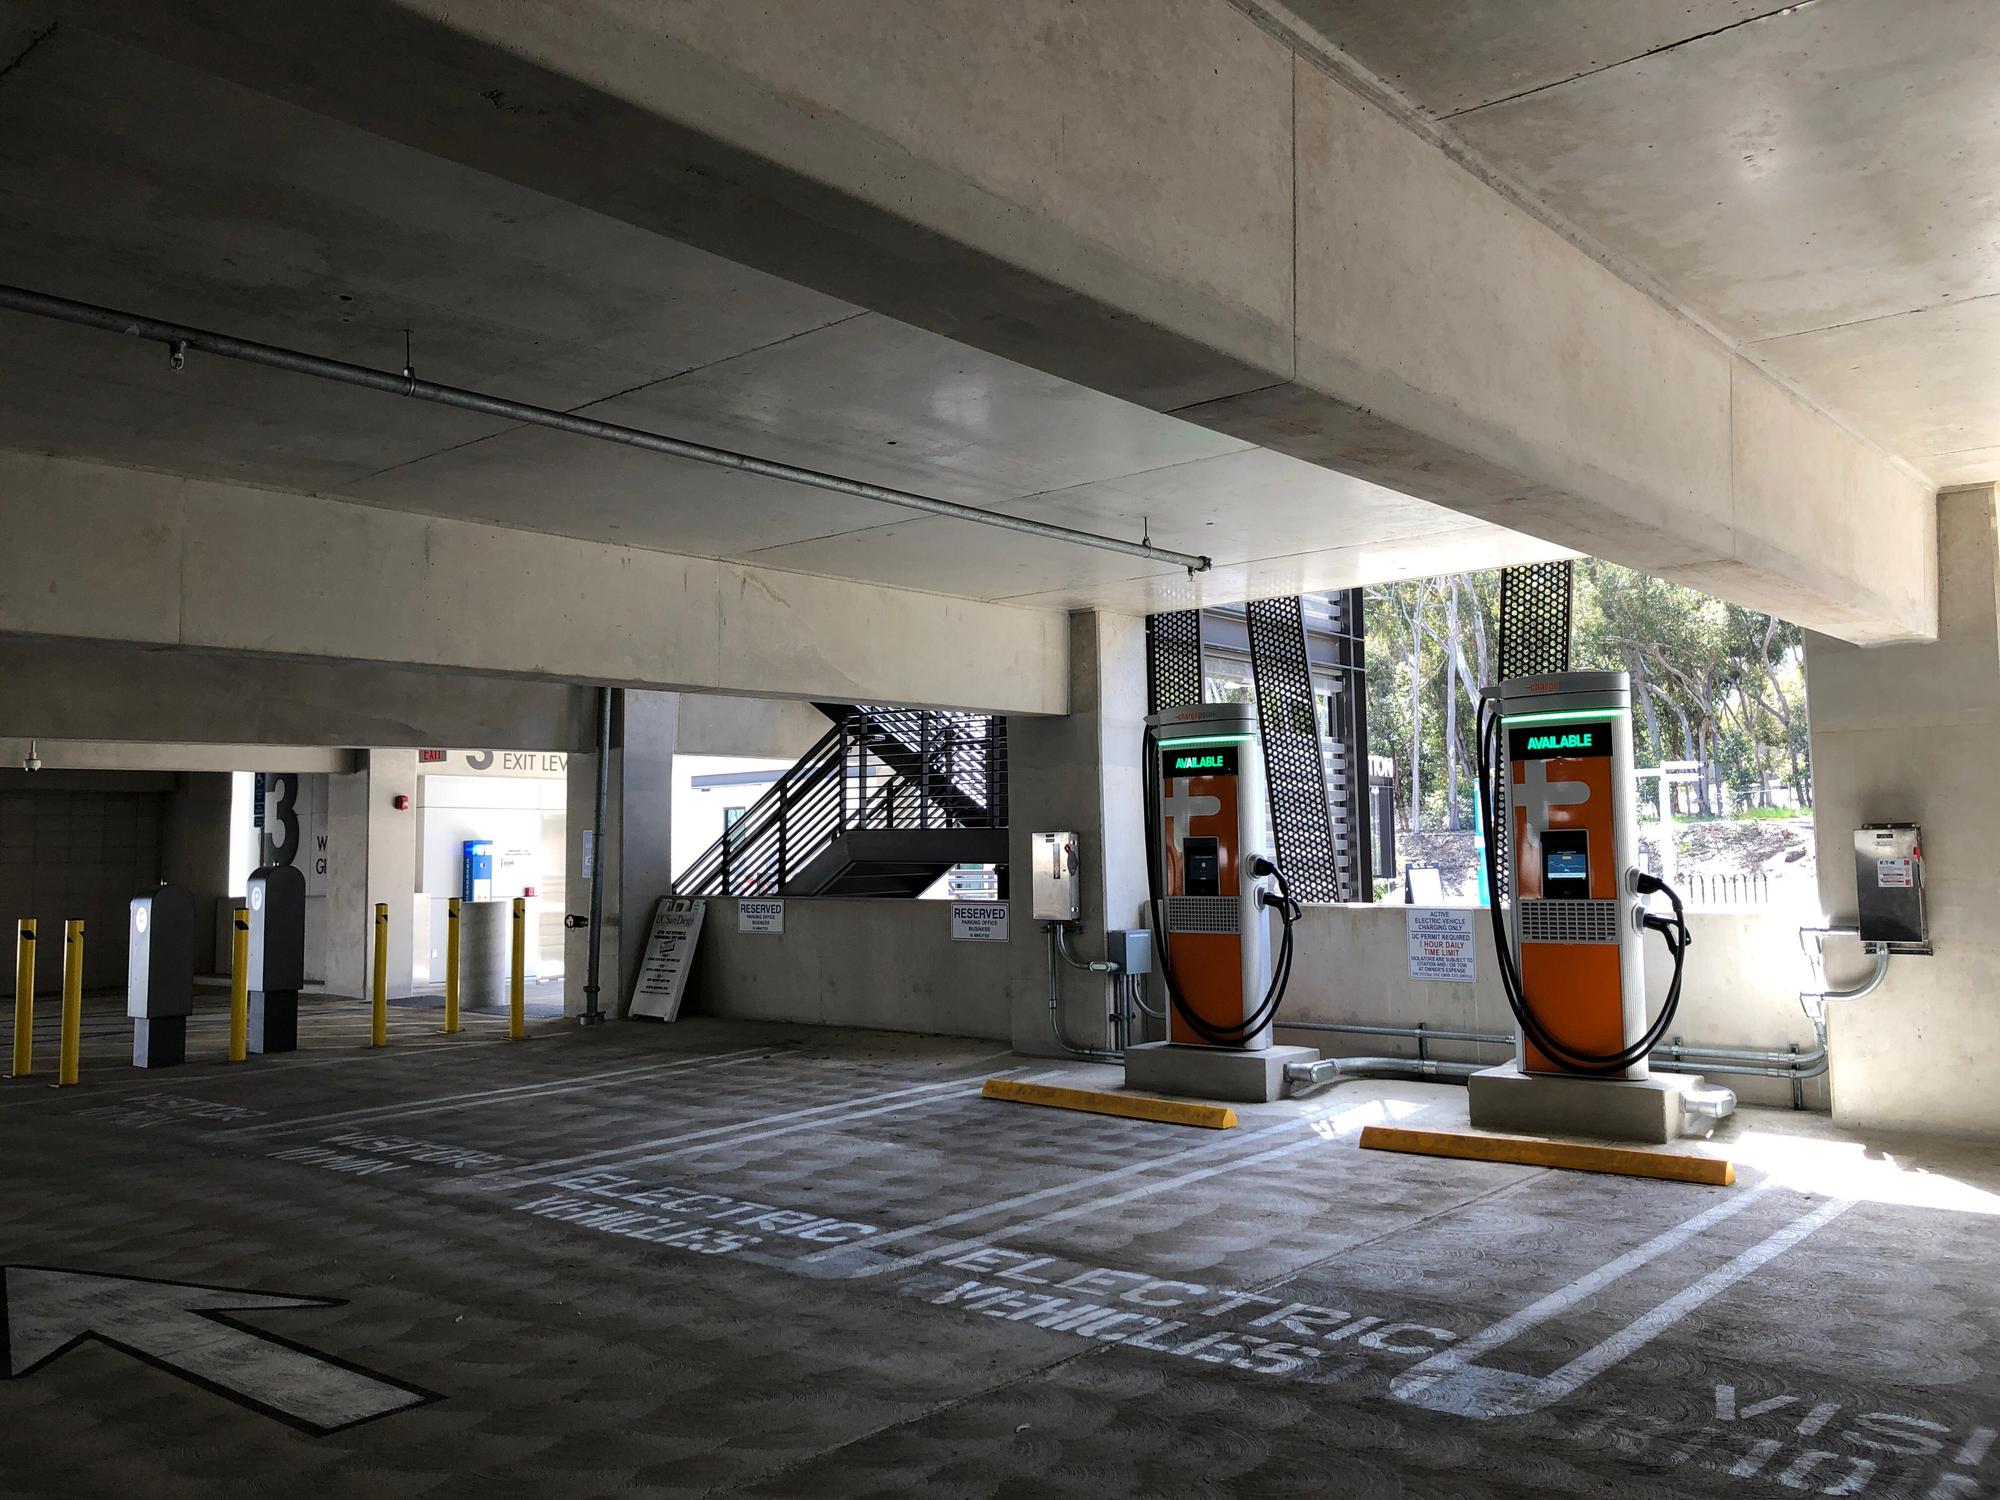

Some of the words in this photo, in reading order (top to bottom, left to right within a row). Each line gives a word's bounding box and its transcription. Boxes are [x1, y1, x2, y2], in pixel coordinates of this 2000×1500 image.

[1527, 734, 1592, 750] AVAILABLE
[424, 750, 441, 761] EXIT
[503, 753, 536, 770] EXIT
[1176, 756, 1223, 768] AVAILABLE
[257, 772, 299, 867] 3
[741, 904, 782, 914] RESERVED
[954, 908, 1006, 919] RESERVED
[552, 1172, 879, 1243] ELECTRIC
[512, 1194, 763, 1255] VEHICLES
[940, 1247, 1457, 1355] ELECTRIC
[931, 1280, 1322, 1375] VEHICLES
